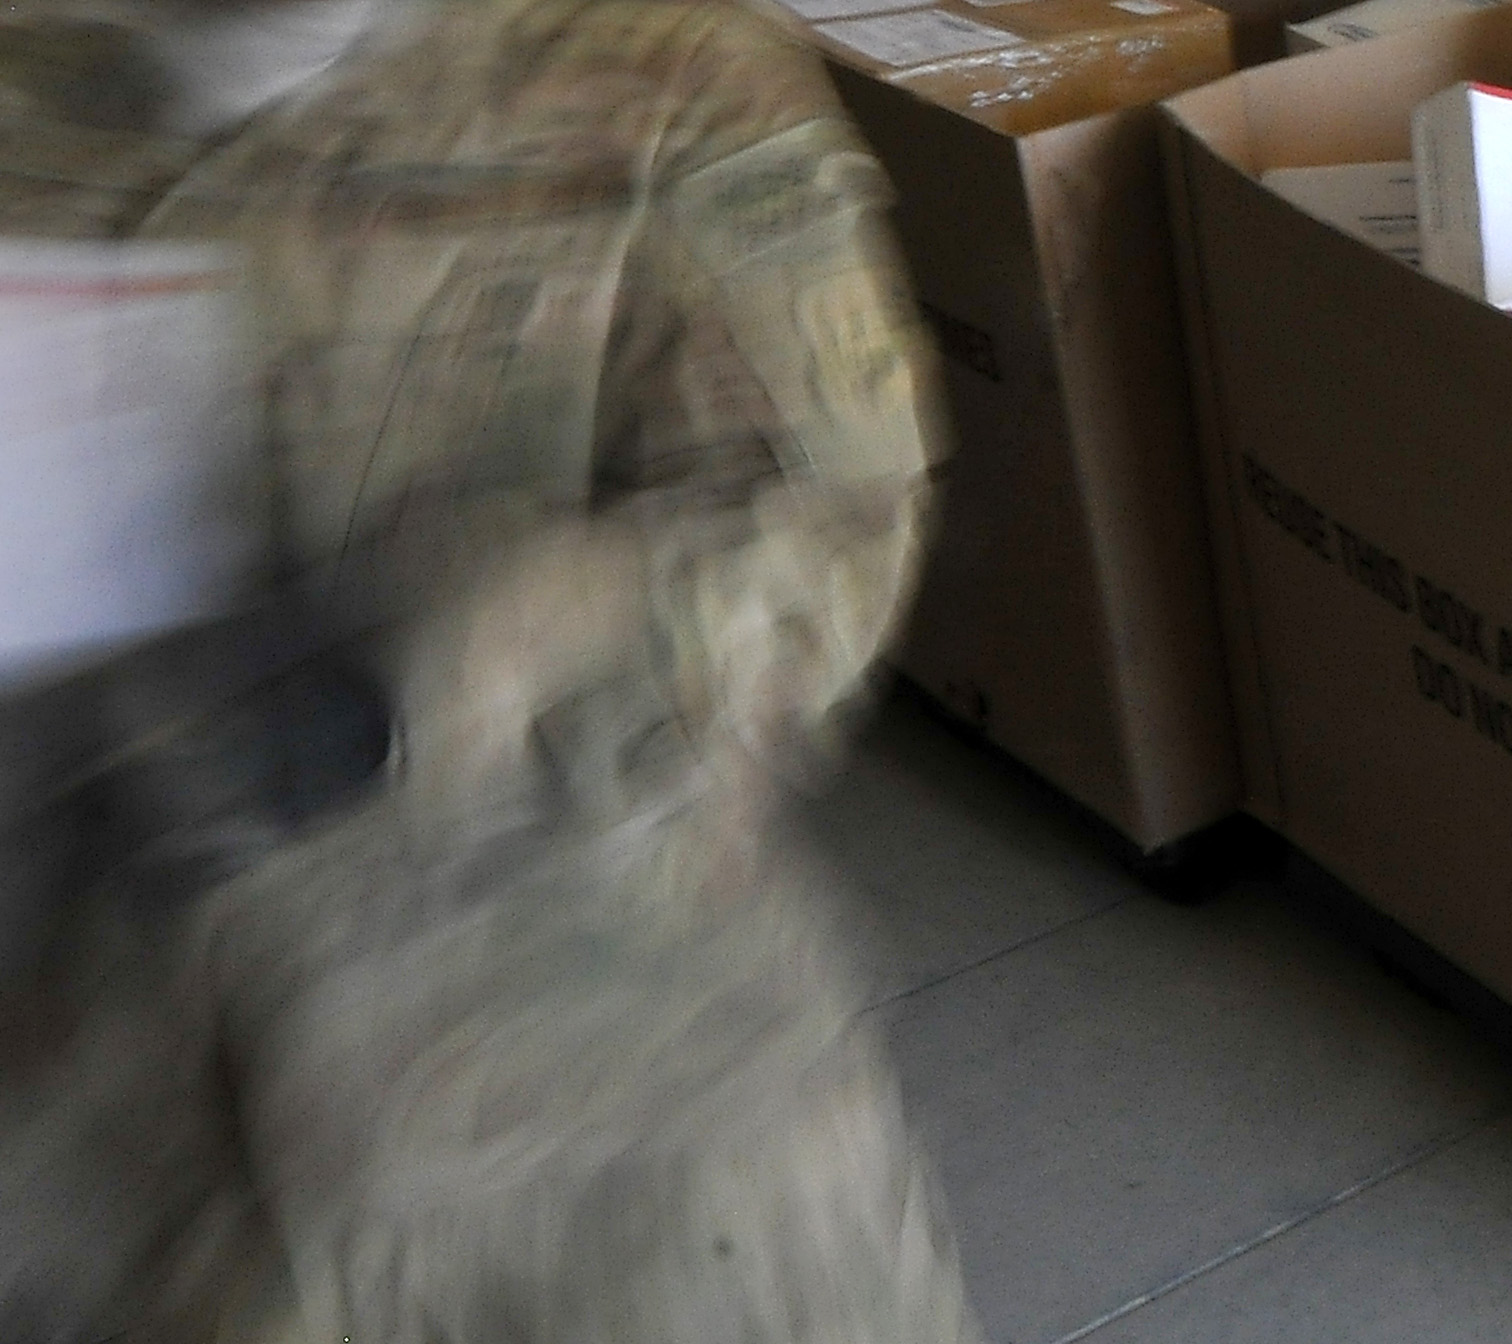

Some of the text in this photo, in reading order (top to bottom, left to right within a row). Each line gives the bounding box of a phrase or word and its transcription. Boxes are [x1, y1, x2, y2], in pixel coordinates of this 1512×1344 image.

[1332, 520, 1412, 614] THIS
[1415, 574, 1489, 666] BOX
[1410, 644, 1465, 719] DO
